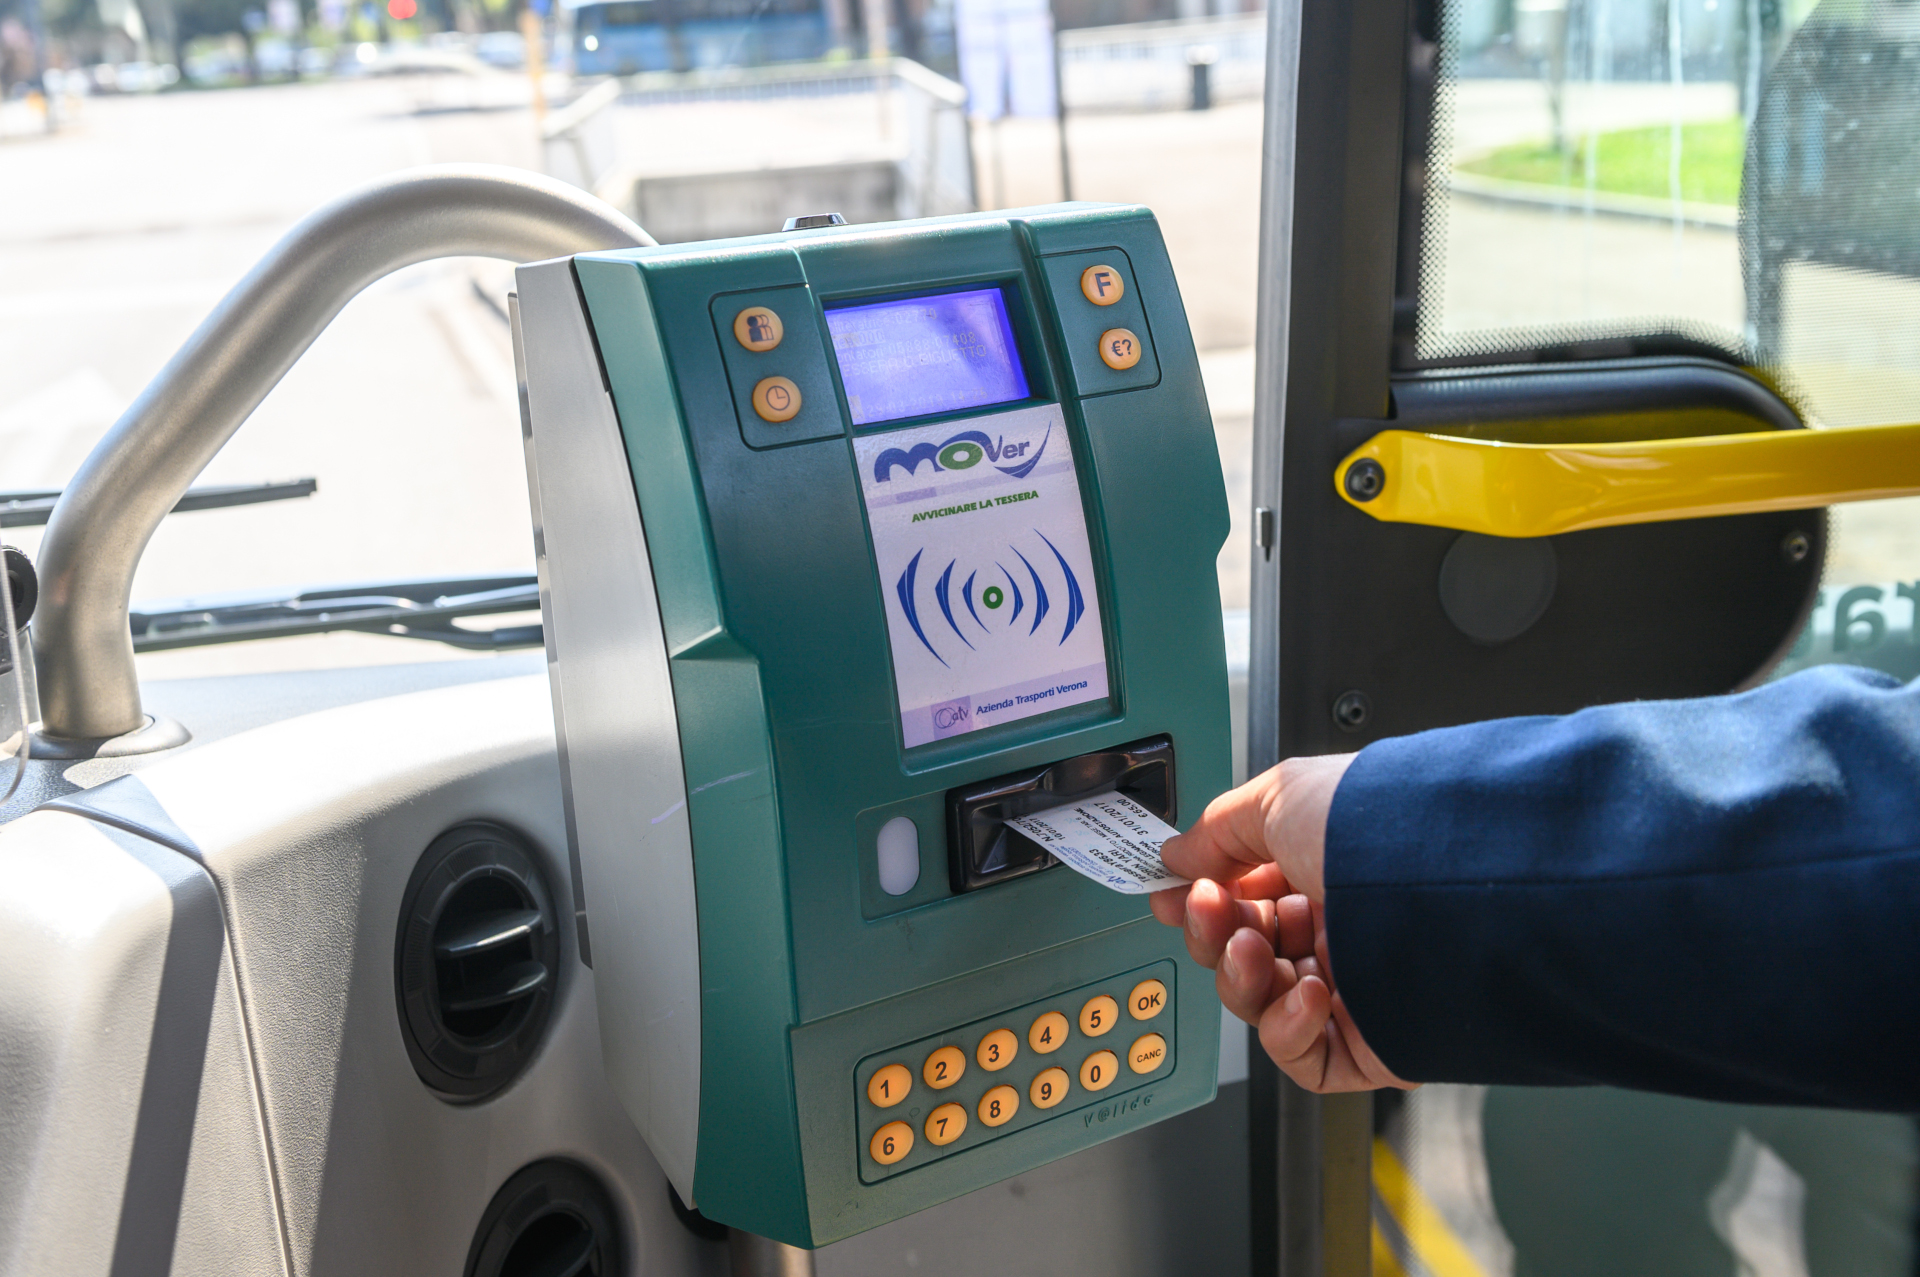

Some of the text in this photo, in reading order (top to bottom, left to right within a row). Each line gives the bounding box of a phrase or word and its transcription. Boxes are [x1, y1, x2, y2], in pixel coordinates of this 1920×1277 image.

[1094, 271, 1112, 297] F
[840, 357, 899, 377] ESSERA
[918, 344, 988, 366] BIGLIETTO
[1111, 338, 1133, 357] €?
[912, 490, 1039, 523] AVVICINARE LA TESSERA
[976, 678, 1088, 715] Azienda Trasporti Verona
[1073, 808, 1155, 860] LEGNAGO AUTOSTAZIONE
[1094, 801, 1148, 836] 31/01/2017
[1108, 849, 1134, 863] YARI
[1132, 863, 1166, 880] BORIN
[880, 993, 1161, 1098] 1 2 3 4 5 OK
[883, 1049, 1161, 1156] 6 7 8 9 0 CANC
